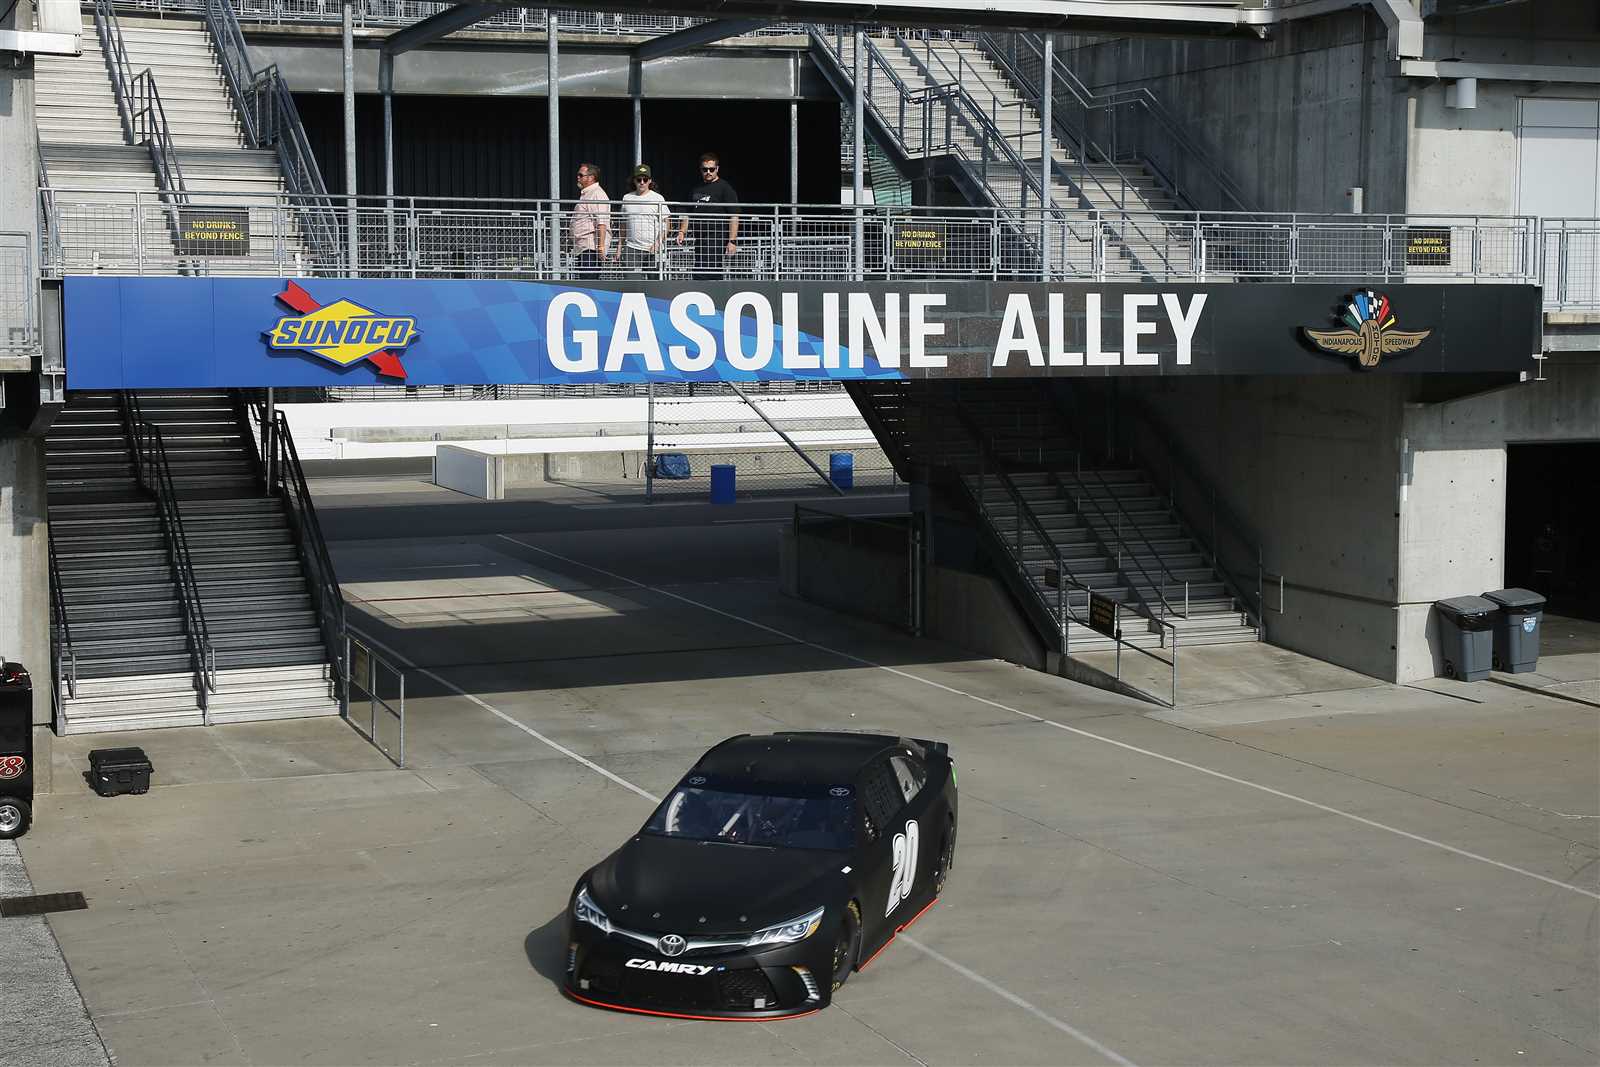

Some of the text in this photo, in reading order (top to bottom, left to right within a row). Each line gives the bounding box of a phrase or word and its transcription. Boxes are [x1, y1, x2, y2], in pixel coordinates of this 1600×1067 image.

[192, 220, 237, 229] NO DRINKS
[184, 231, 245, 240] BEYOND FENCE
[901, 230, 936, 239] NO DRINKS
[895, 240, 922, 248] BEYOND
[277, 320, 411, 344] SUNOCO
[546, 291, 1208, 373] GASOLINE ALLEY
[1322, 325, 1415, 362] INDIANAPOLIS MOTOR SPEEDWAY
[885, 820, 919, 918] 20
[625, 959, 714, 975] CAMRY
